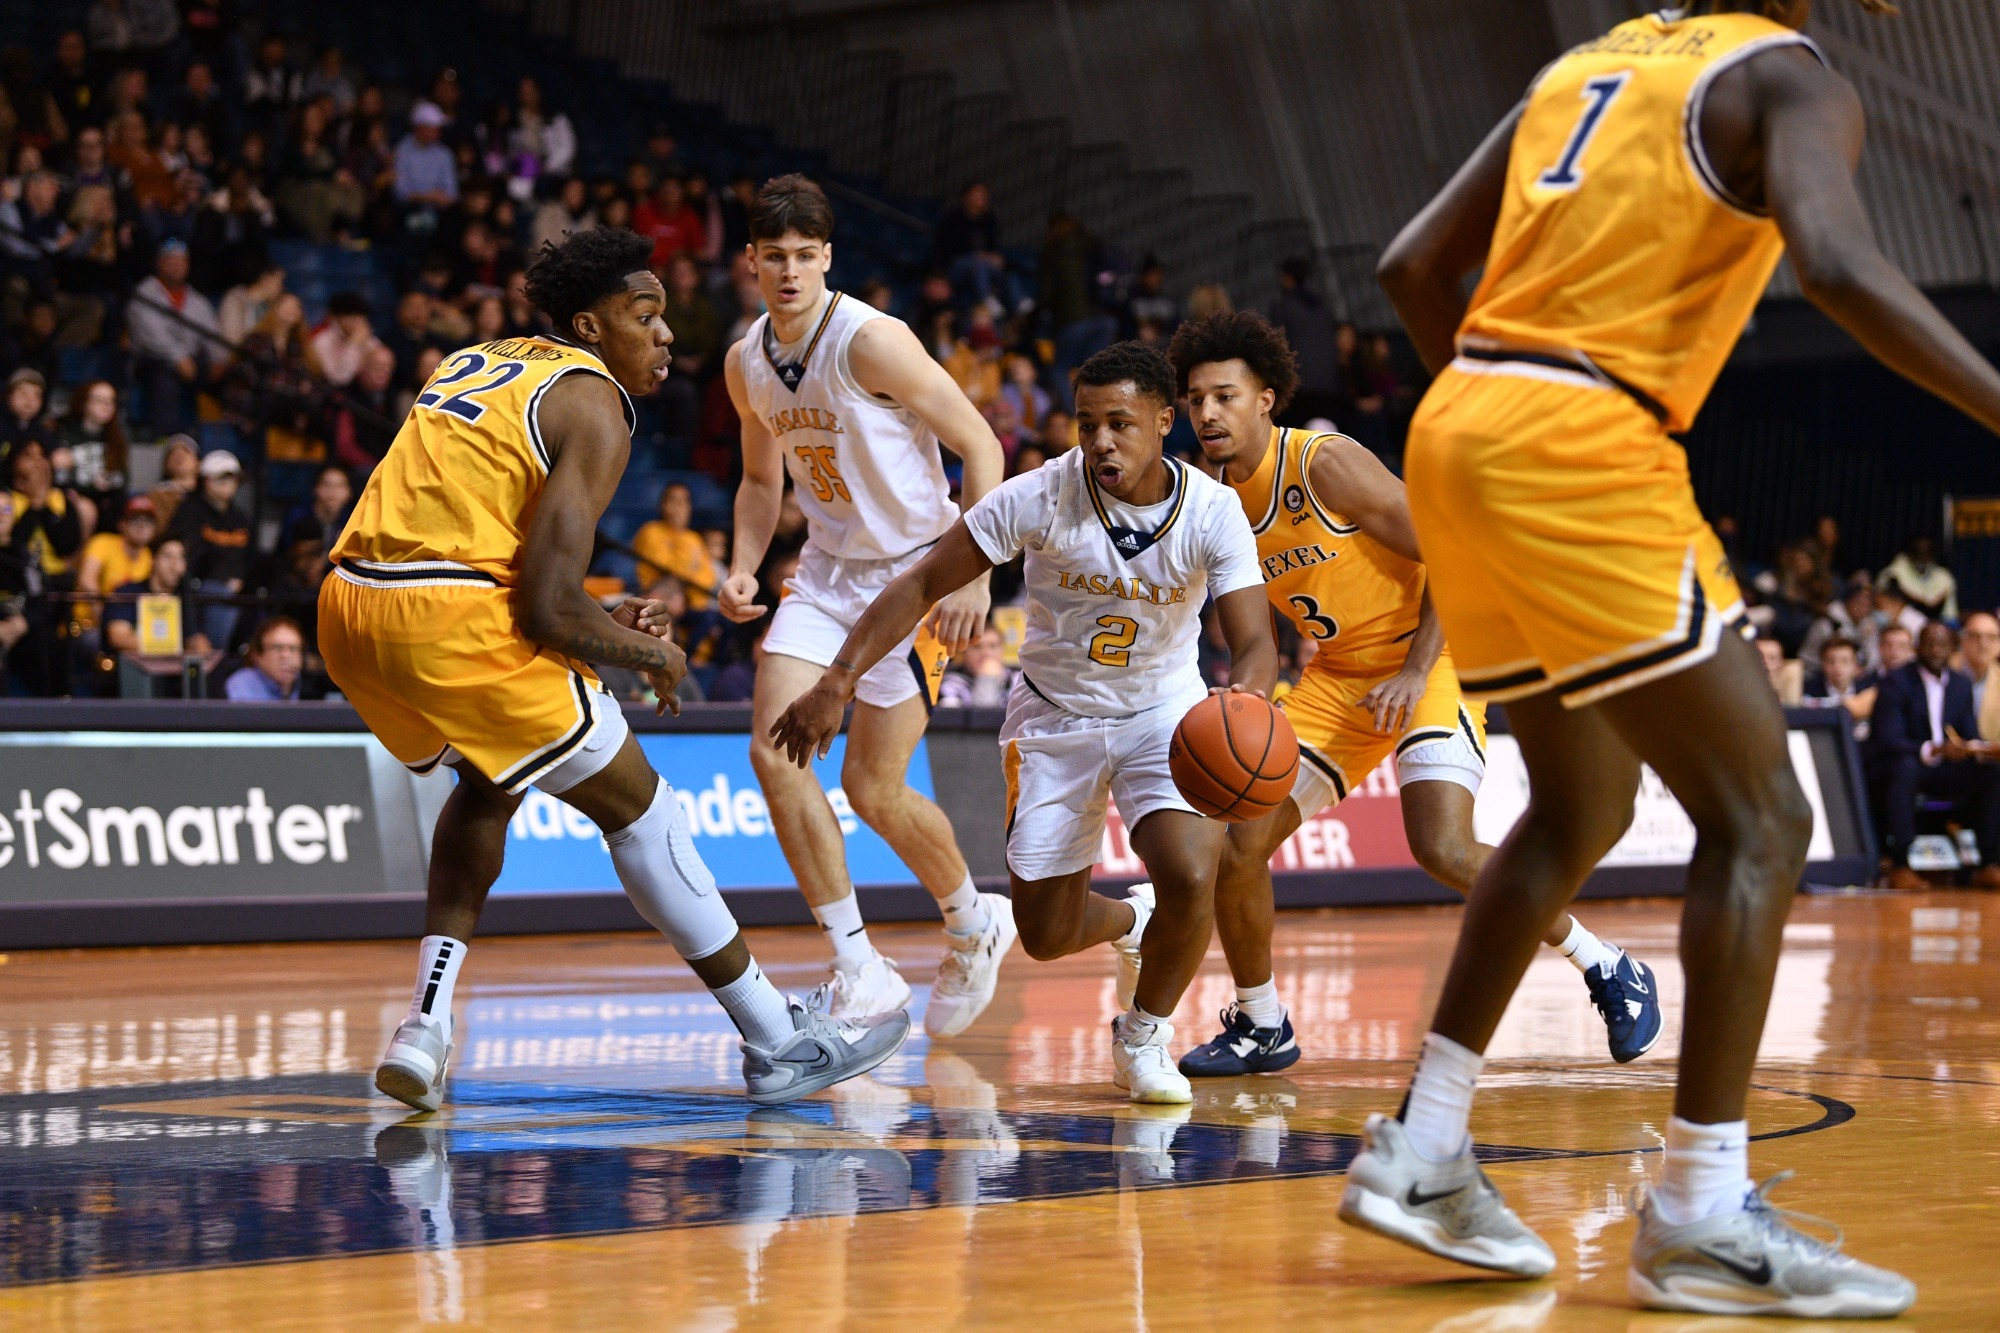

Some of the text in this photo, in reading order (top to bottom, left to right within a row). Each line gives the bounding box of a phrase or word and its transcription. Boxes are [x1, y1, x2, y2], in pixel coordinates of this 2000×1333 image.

[1535, 69, 1634, 191] 1
[414, 351, 528, 426] 22
[794, 445, 852, 503] 35
[1292, 512, 1311, 526] CAA
[1116, 541, 1140, 551] adidas
[1262, 543, 1339, 584] EXEL
[1058, 571, 1187, 606] LASALLE
[1088, 614, 1140, 668] 2
[1287, 593, 1341, 642] 3
